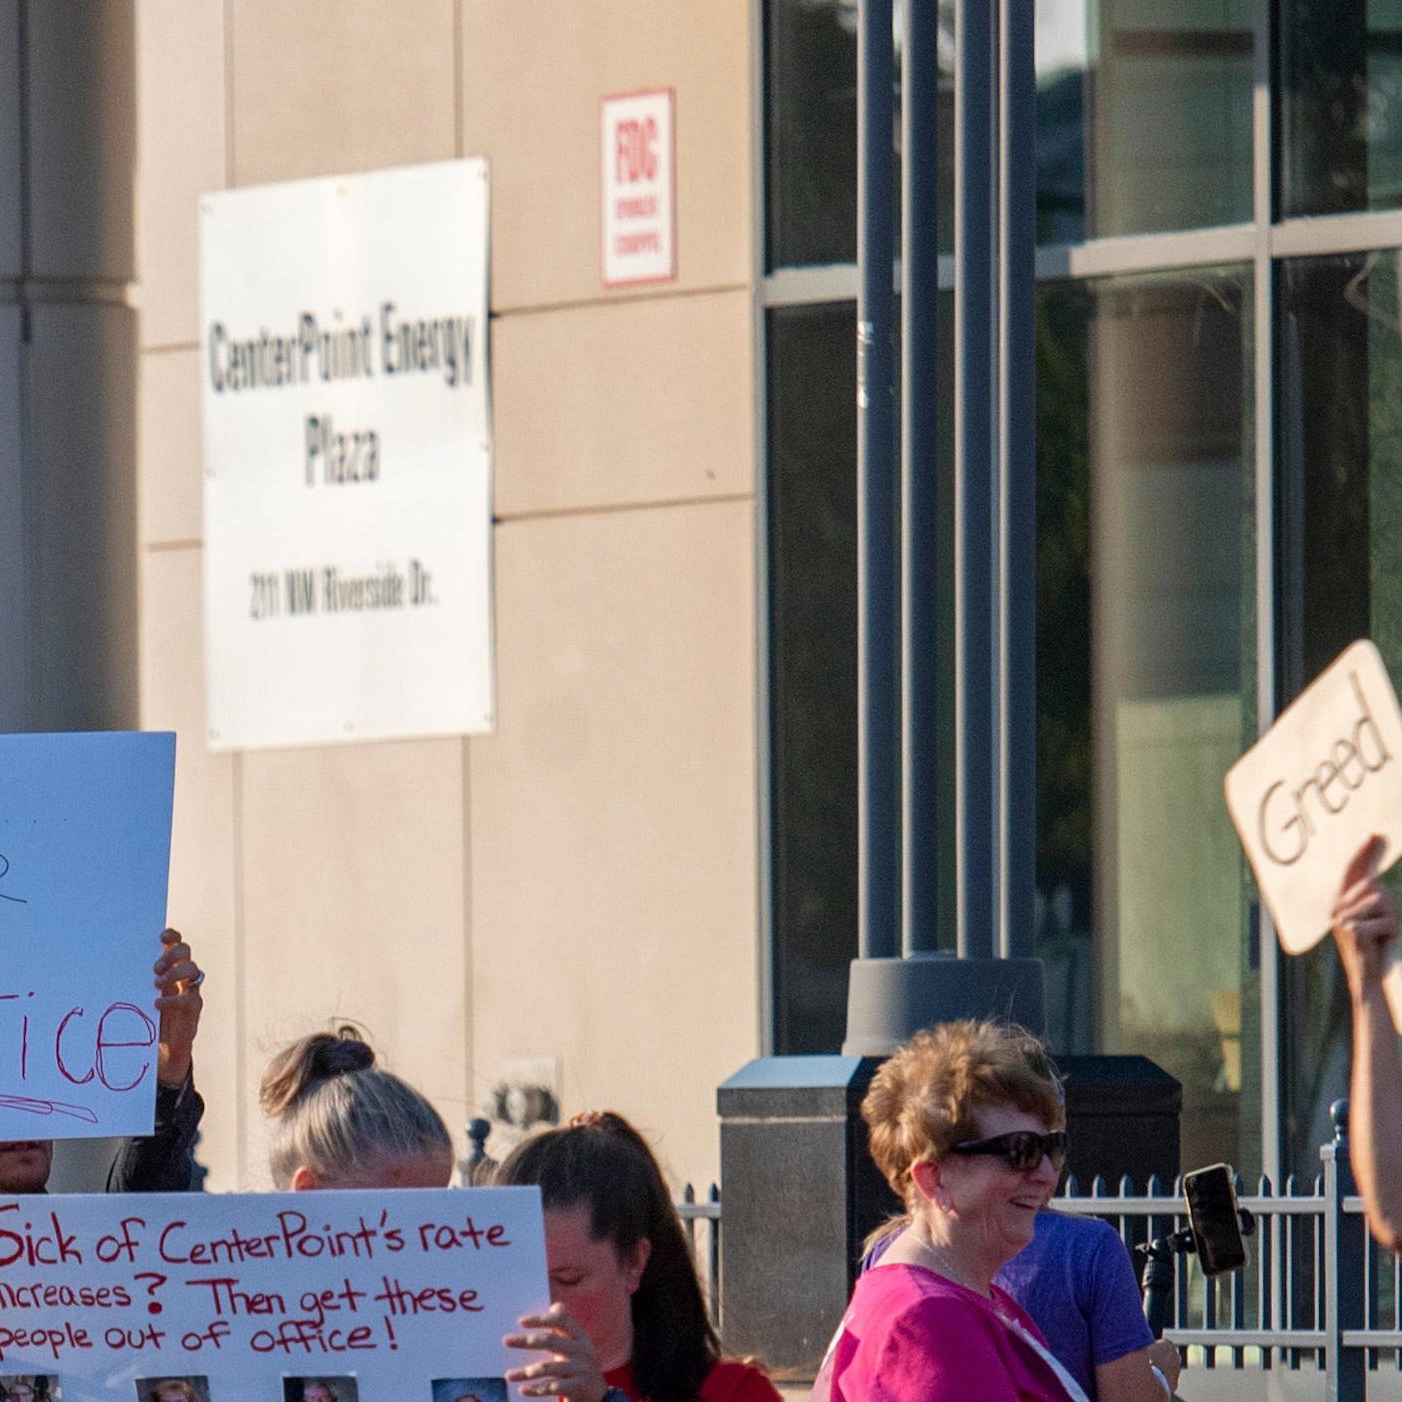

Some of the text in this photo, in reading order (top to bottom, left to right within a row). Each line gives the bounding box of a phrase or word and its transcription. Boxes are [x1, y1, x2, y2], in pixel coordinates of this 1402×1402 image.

[208, 301, 476, 394] CenterPoint Energy
[304, 413, 380, 488] Plaza
[250, 572, 279, 621] 211
[322, 560, 404, 613] Riverside
[409, 557, 439, 607] Dr.
[1258, 669, 1393, 866] Greed
[96, 1218, 145, 1262] of
[159, 1209, 405, 1264] CenterPoint's
[419, 1216, 511, 1251] rate
[185, 1278, 286, 1314] Then
[300, 1279, 367, 1328] get
[375, 1276, 484, 1315] these
[105, 1323, 166, 1349] out
[181, 1321, 230, 1351] of
[250, 1316, 398, 1354] office!
